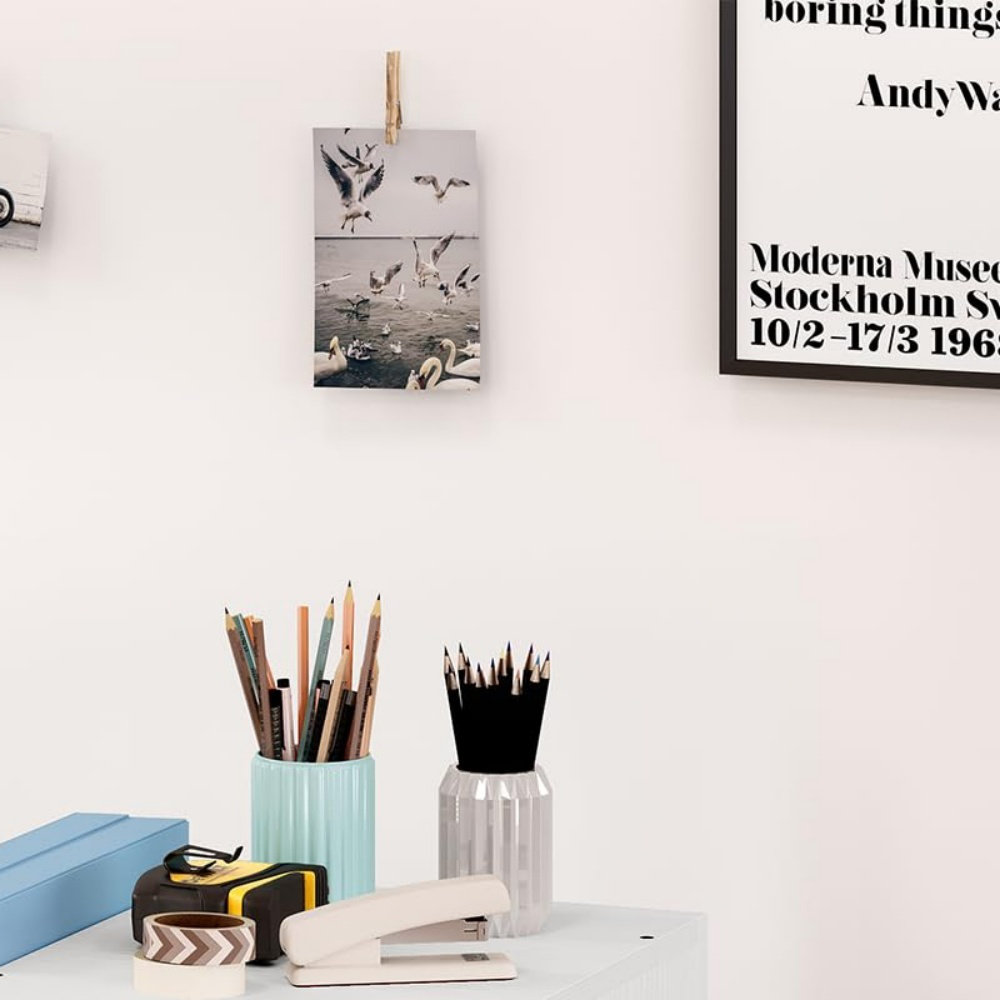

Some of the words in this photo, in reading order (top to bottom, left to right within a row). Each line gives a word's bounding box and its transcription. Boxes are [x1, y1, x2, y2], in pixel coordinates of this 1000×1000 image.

[764, 0, 887, 35] boring
[748, 242, 893, 279] Moderna
[749, 278, 957, 318] Stockholm
[930, 326, 1000, 359] 196
